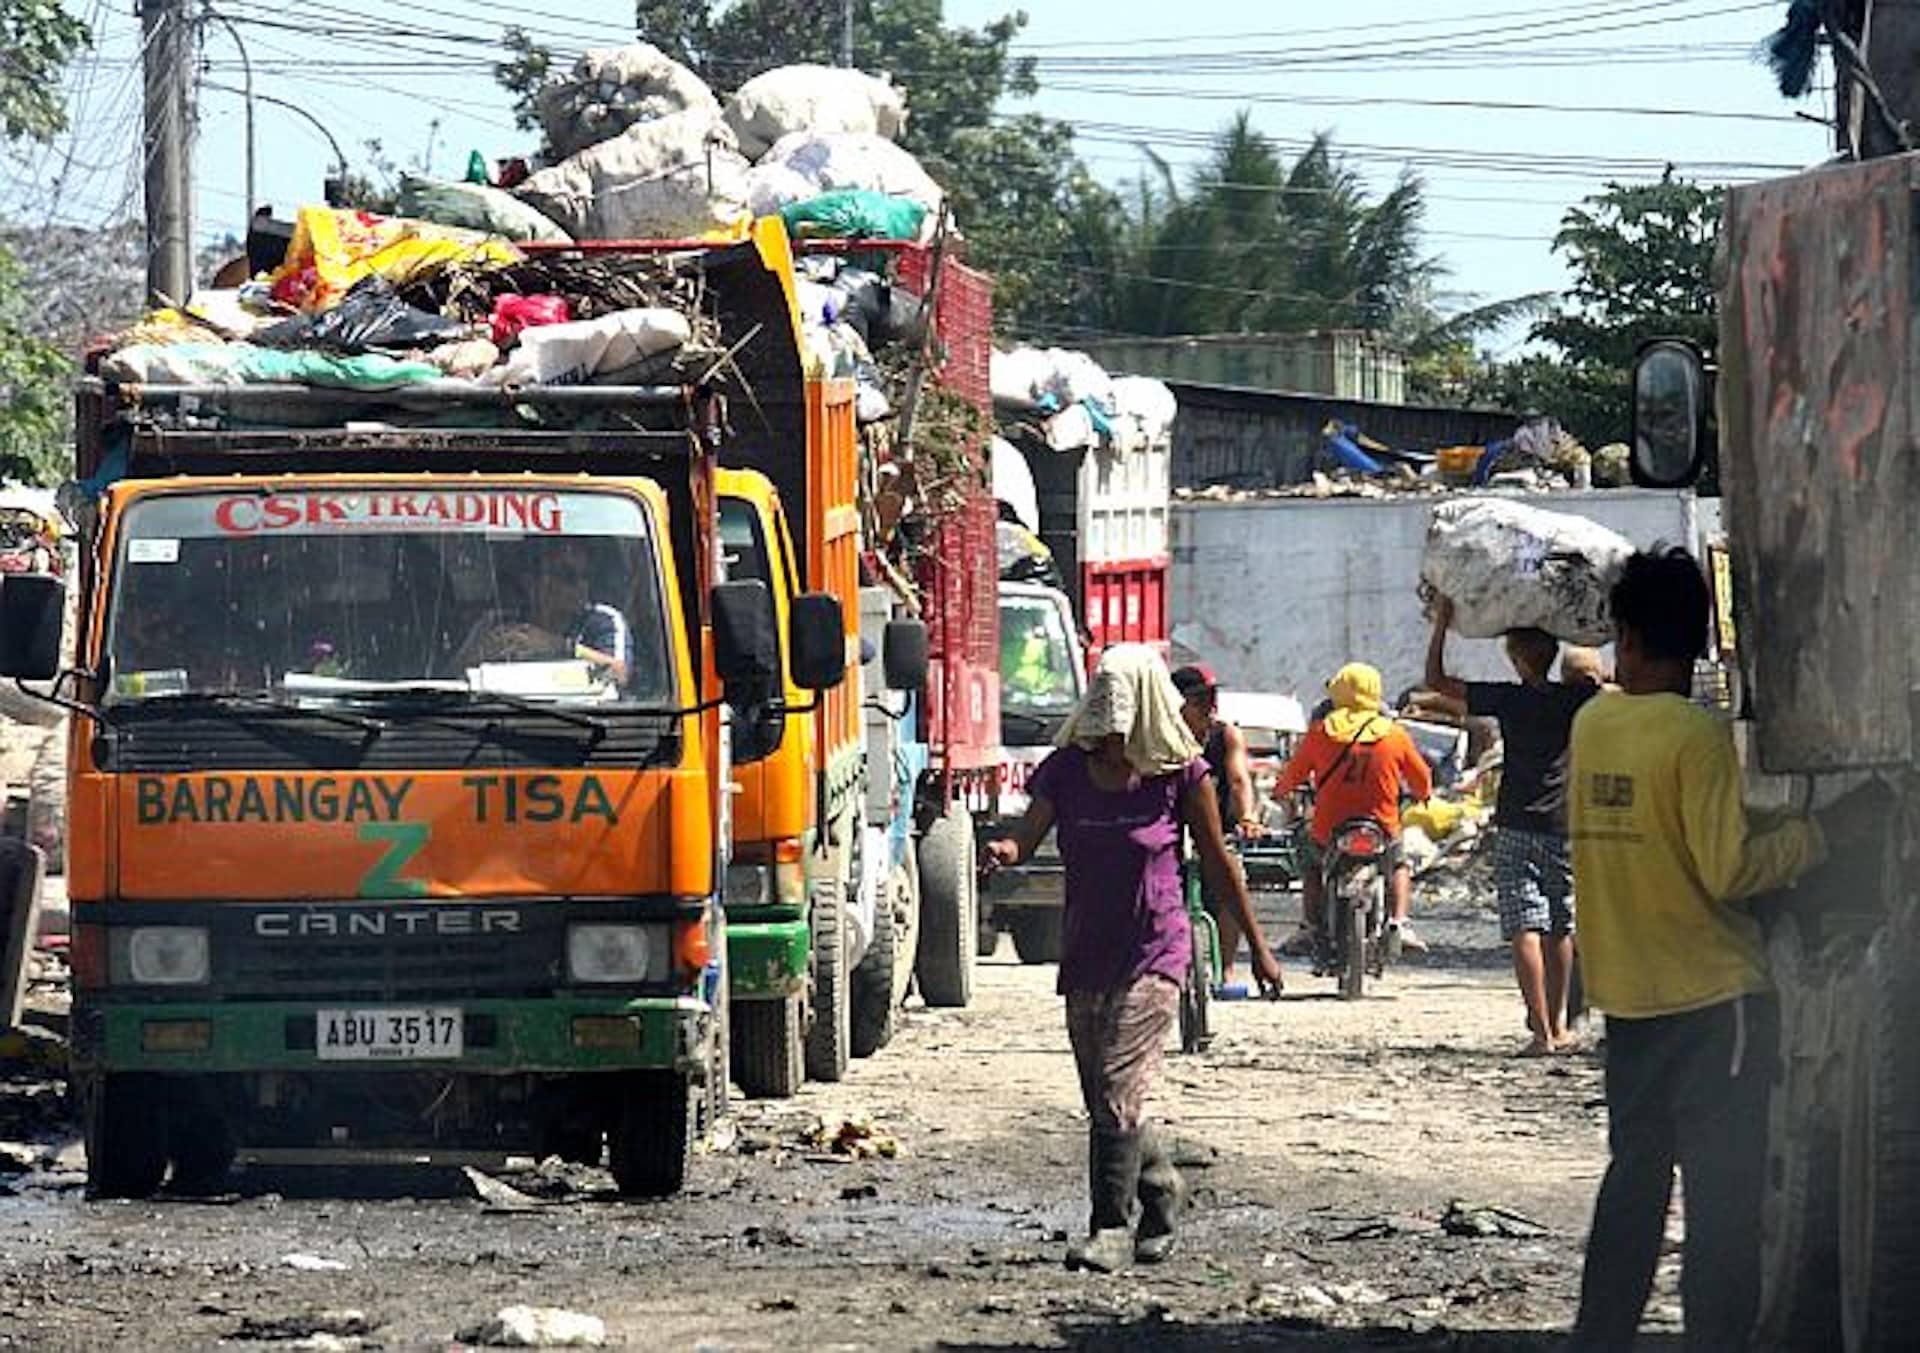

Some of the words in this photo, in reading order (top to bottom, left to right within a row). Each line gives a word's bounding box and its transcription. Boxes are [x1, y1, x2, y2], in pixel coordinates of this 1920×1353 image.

[368, 492, 563, 532] TRADING
[136, 776, 414, 826] BARANGAY
[462, 774, 619, 826] TISA
[254, 908, 521, 937] CANTER
[326, 1016, 376, 1046] ABU
[389, 1015, 456, 1046] 3517
